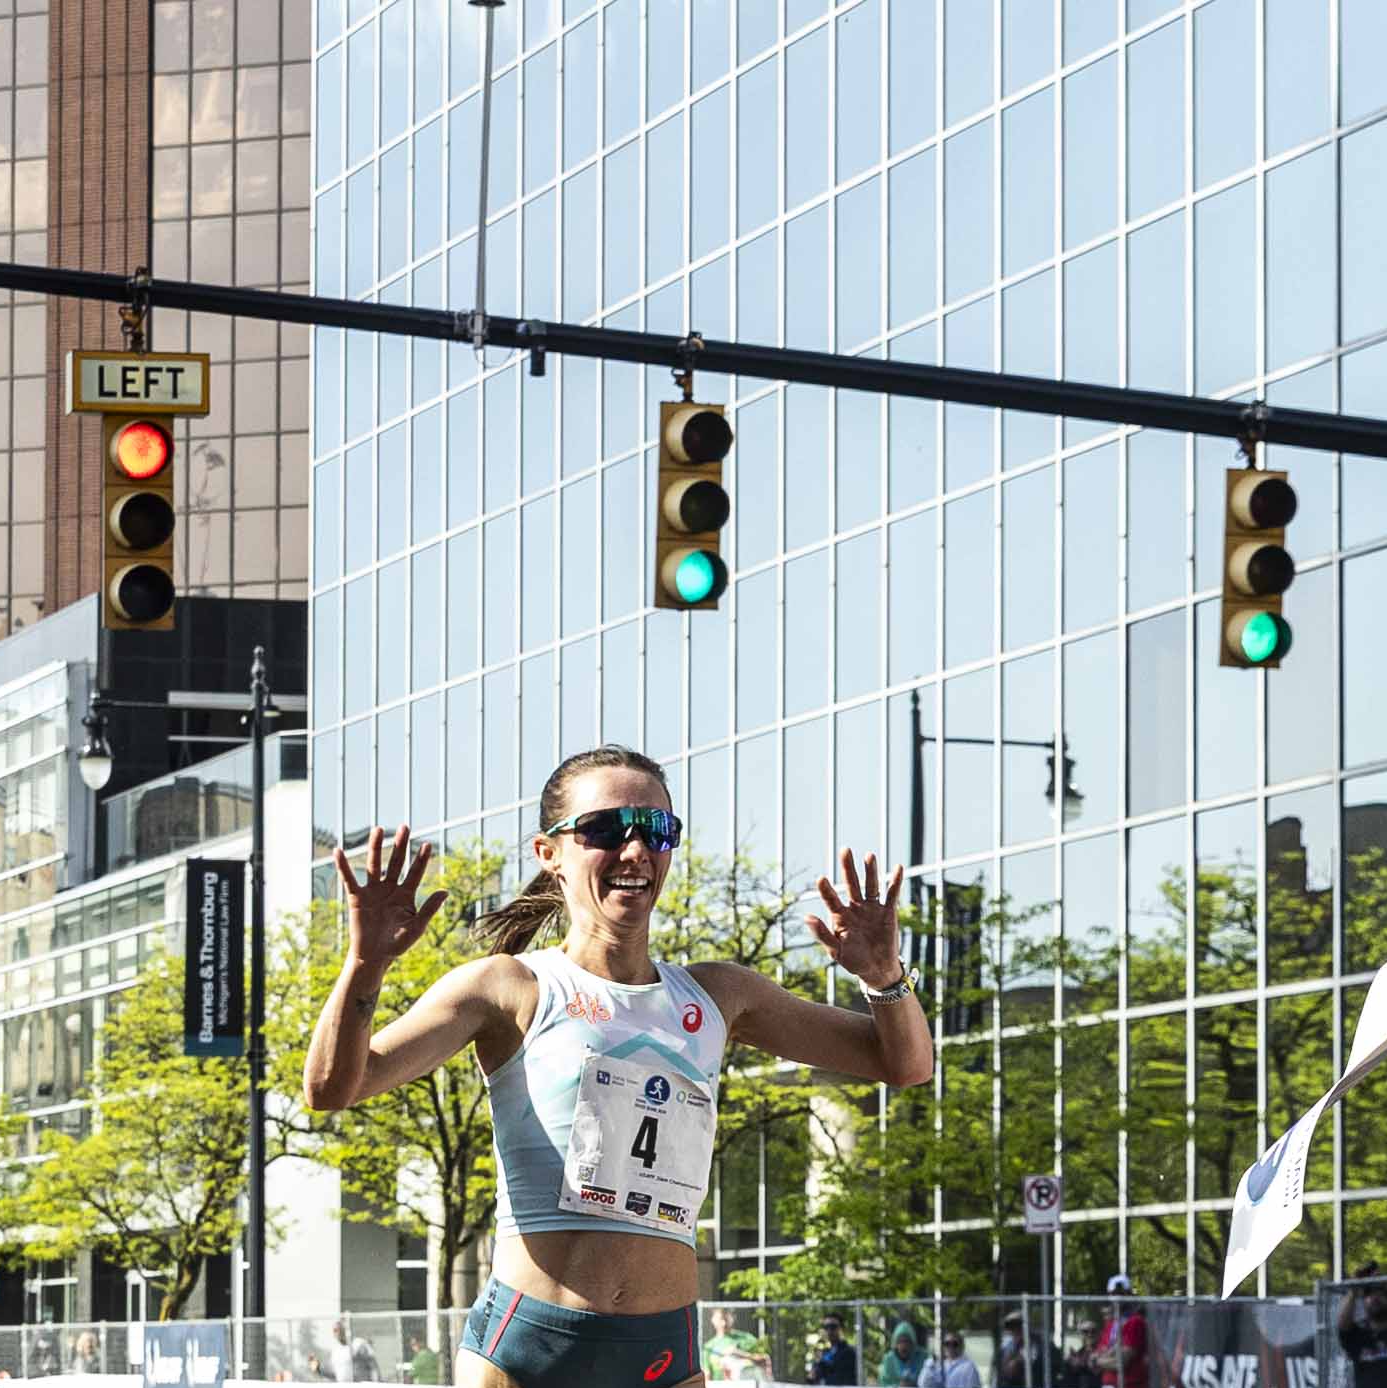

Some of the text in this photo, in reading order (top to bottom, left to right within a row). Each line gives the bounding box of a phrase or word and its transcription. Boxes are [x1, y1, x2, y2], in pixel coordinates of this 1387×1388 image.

[98, 364, 185, 400] LEFT
[199, 872, 219, 1043] Barnes & Thornburg
[630, 1115, 659, 1170] 4
[580, 1189, 616, 1206] WOOD
